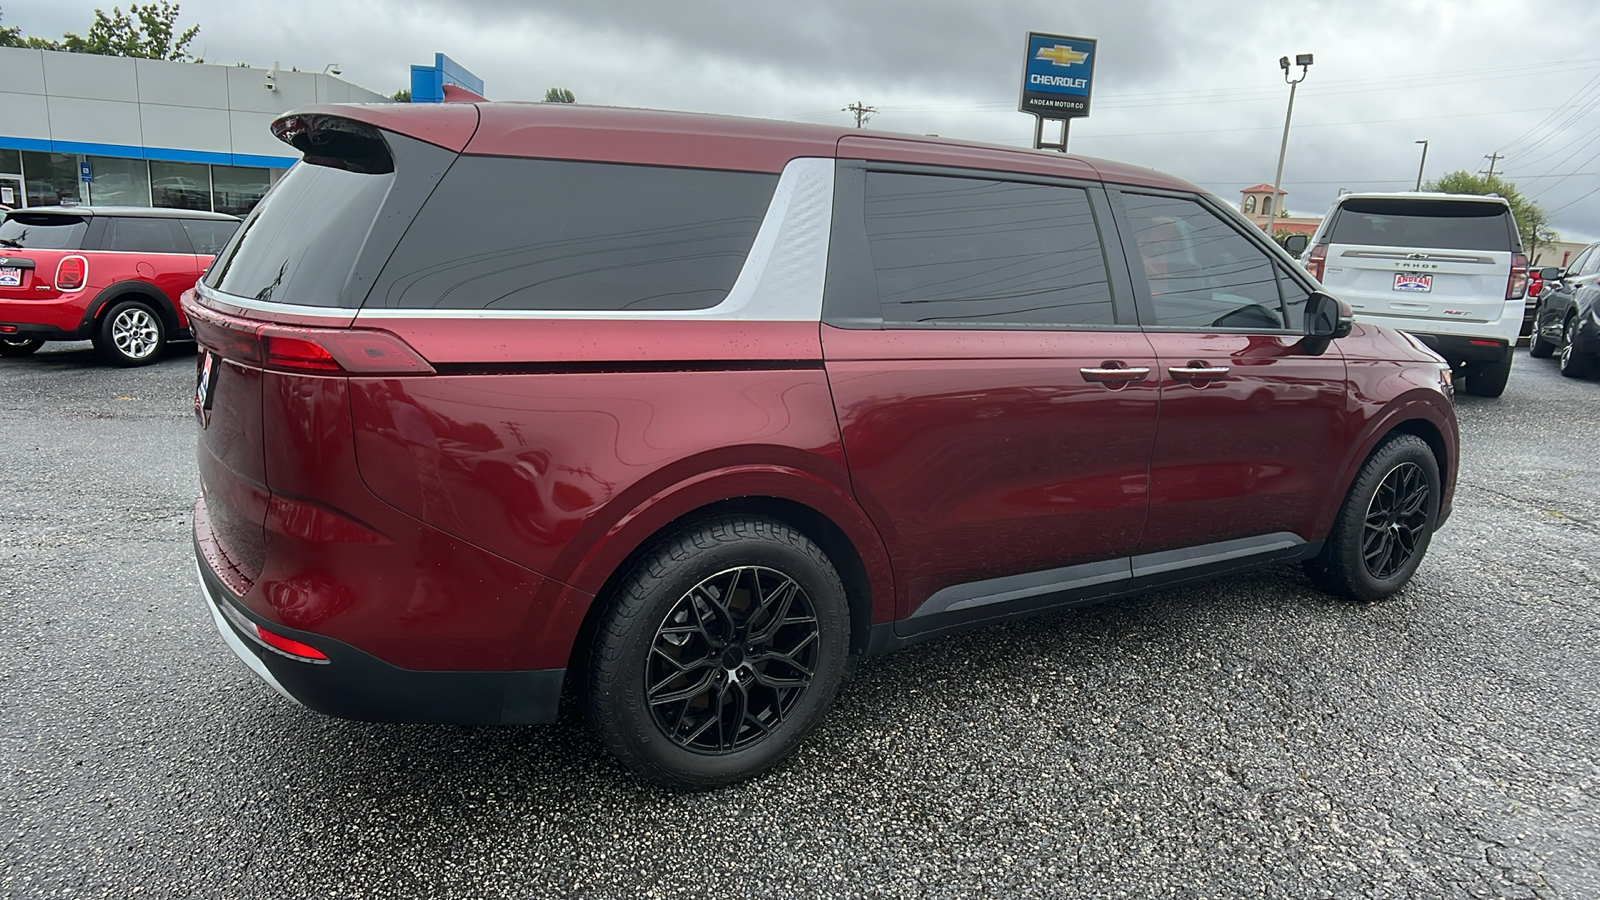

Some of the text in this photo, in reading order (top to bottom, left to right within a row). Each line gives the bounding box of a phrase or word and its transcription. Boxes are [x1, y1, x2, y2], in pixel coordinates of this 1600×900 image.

[1030, 73, 1088, 89] CHEVROLET
[1029, 98, 1054, 106] ANDEAN
[1055, 101, 1075, 109] MOTOR
[1396, 276, 1430, 286] ANDEAN
